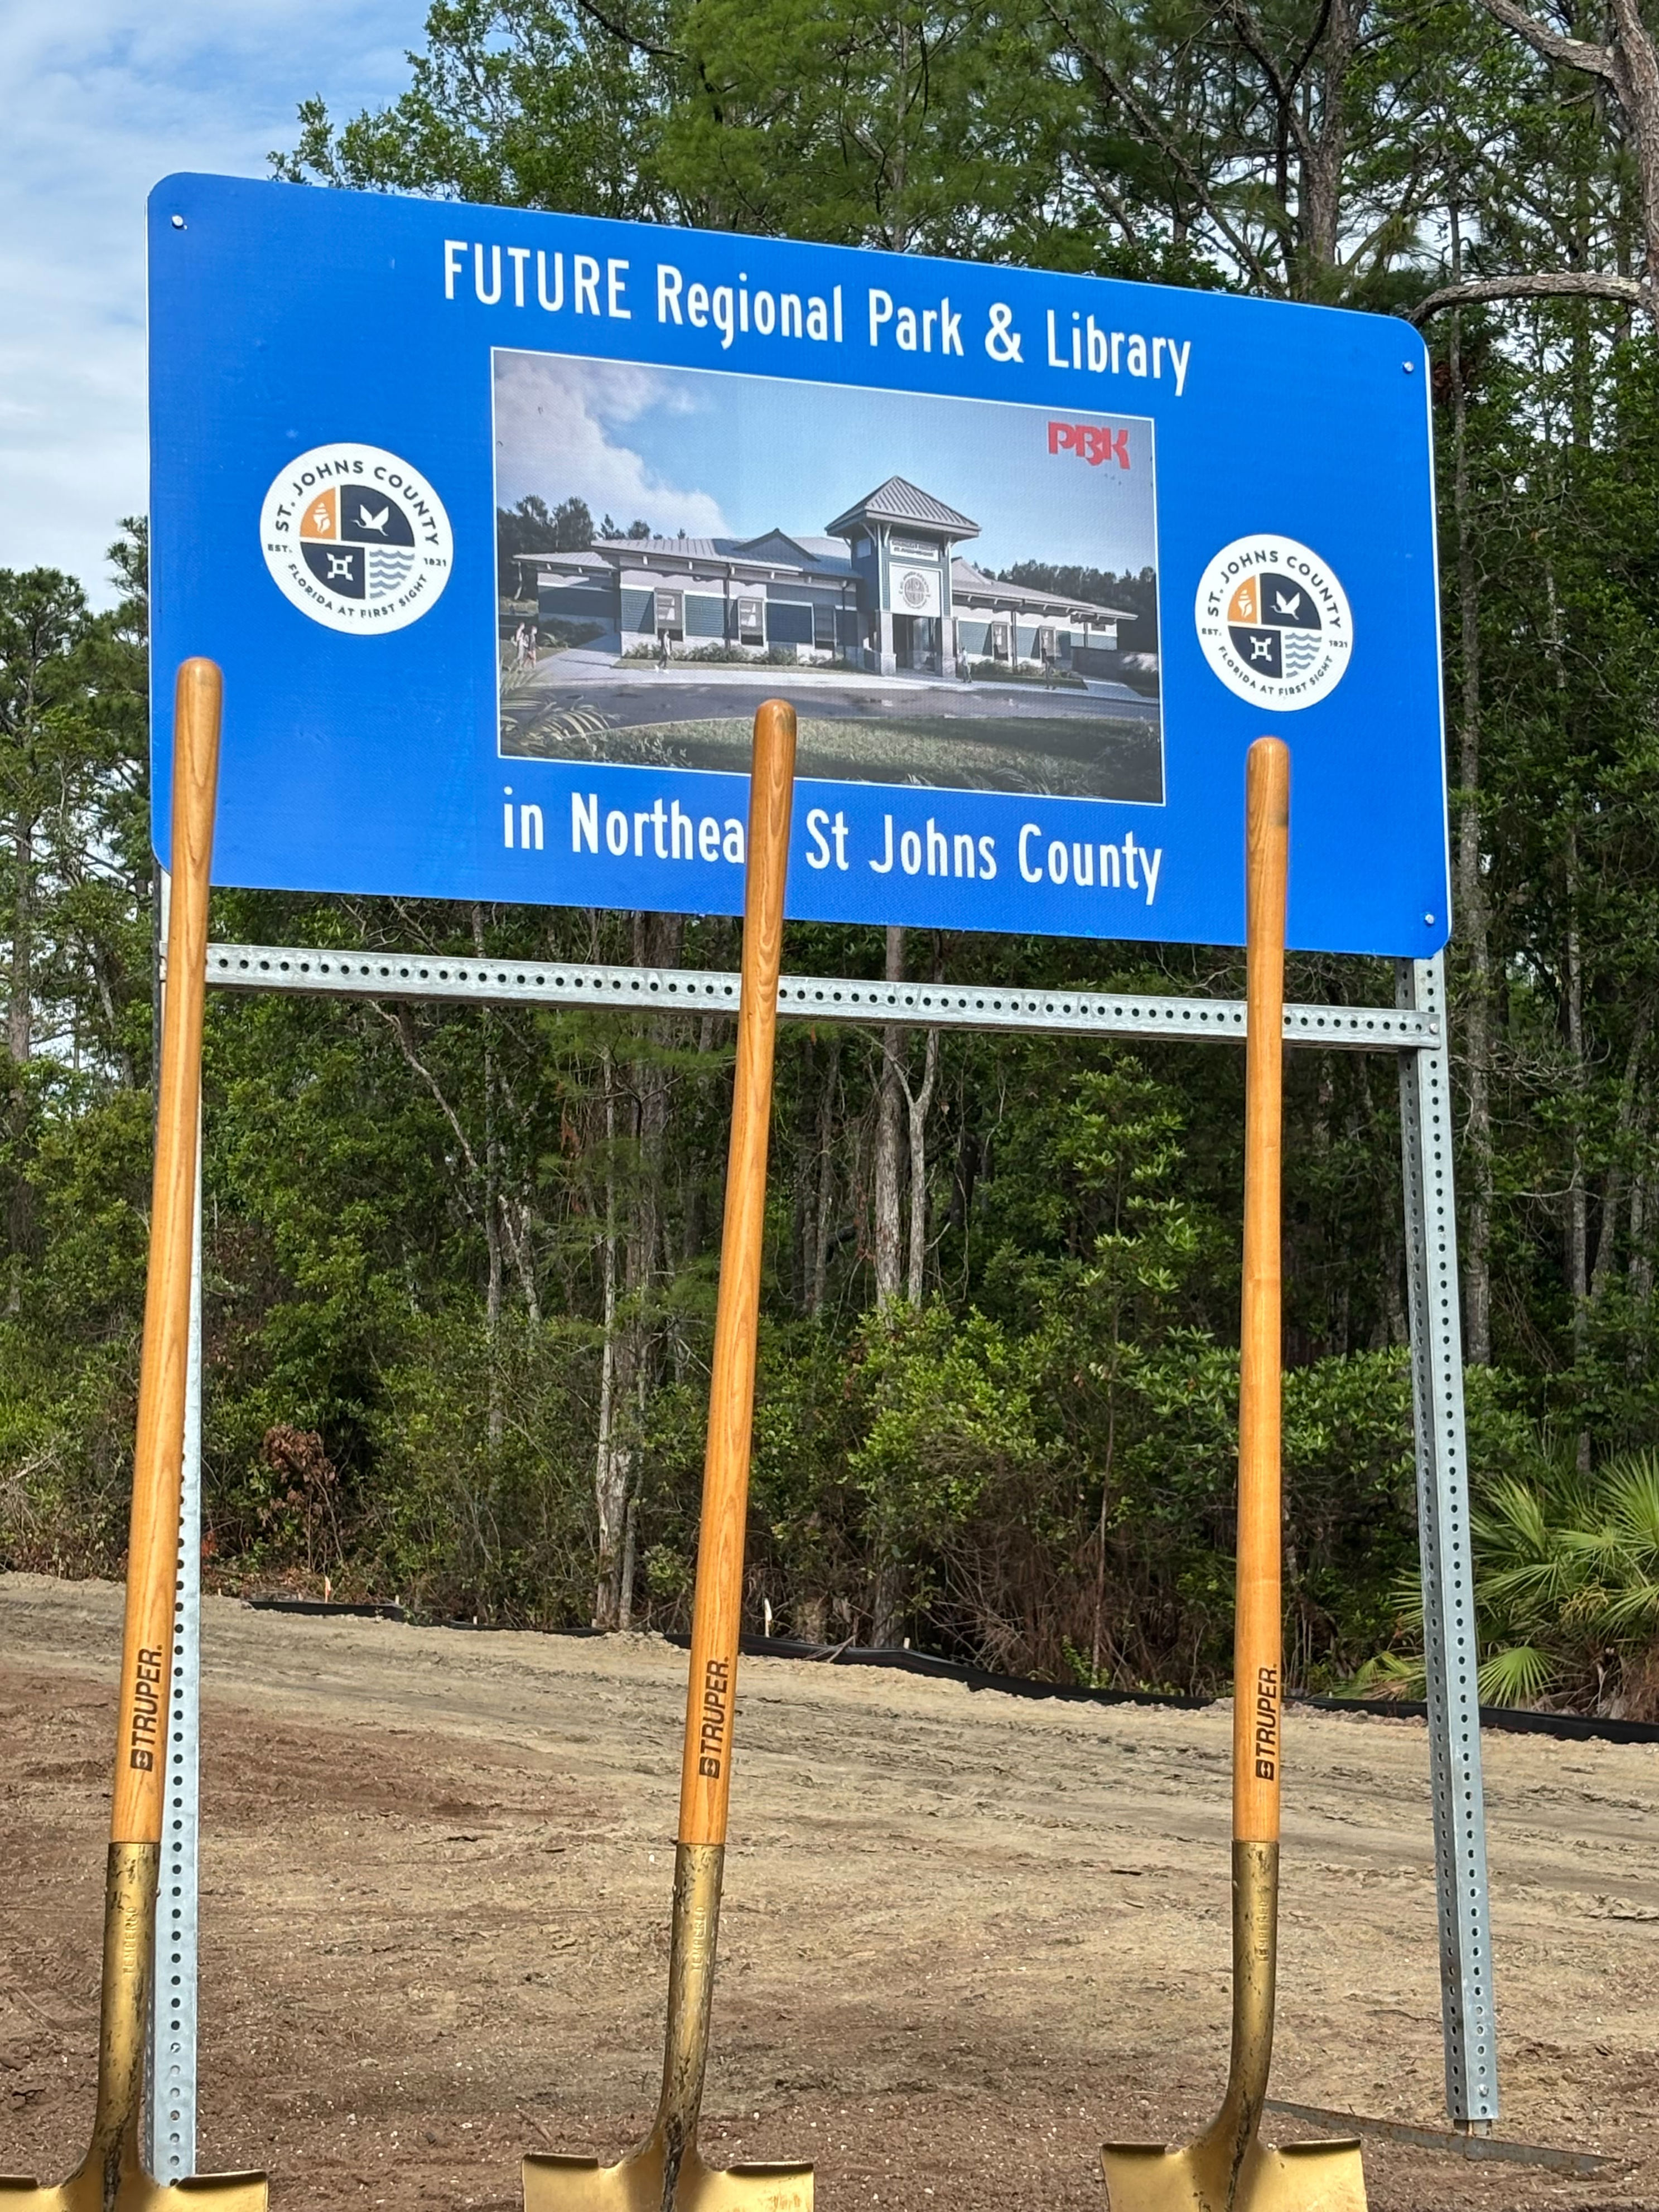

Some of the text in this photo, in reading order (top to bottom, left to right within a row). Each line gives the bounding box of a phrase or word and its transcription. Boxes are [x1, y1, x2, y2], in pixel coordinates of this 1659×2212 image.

[444, 239, 1191, 397] FUTURE Regional Park & Library
[1047, 421, 1131, 470] PBK
[275, 460, 440, 546] ST. JOHNS COUNTY
[268, 544, 447, 567] EST. 1821
[287, 563, 427, 619] FLORIDA AT FIRST SIGHT
[1207, 549, 1342, 629] ST. JOHNS COUNTY
[1201, 627, 1222, 637] EST.
[1218, 645, 1334, 696] FLORIDA AT FIRST SIGHT
[504, 785, 1163, 906] in Northea St Johns County
